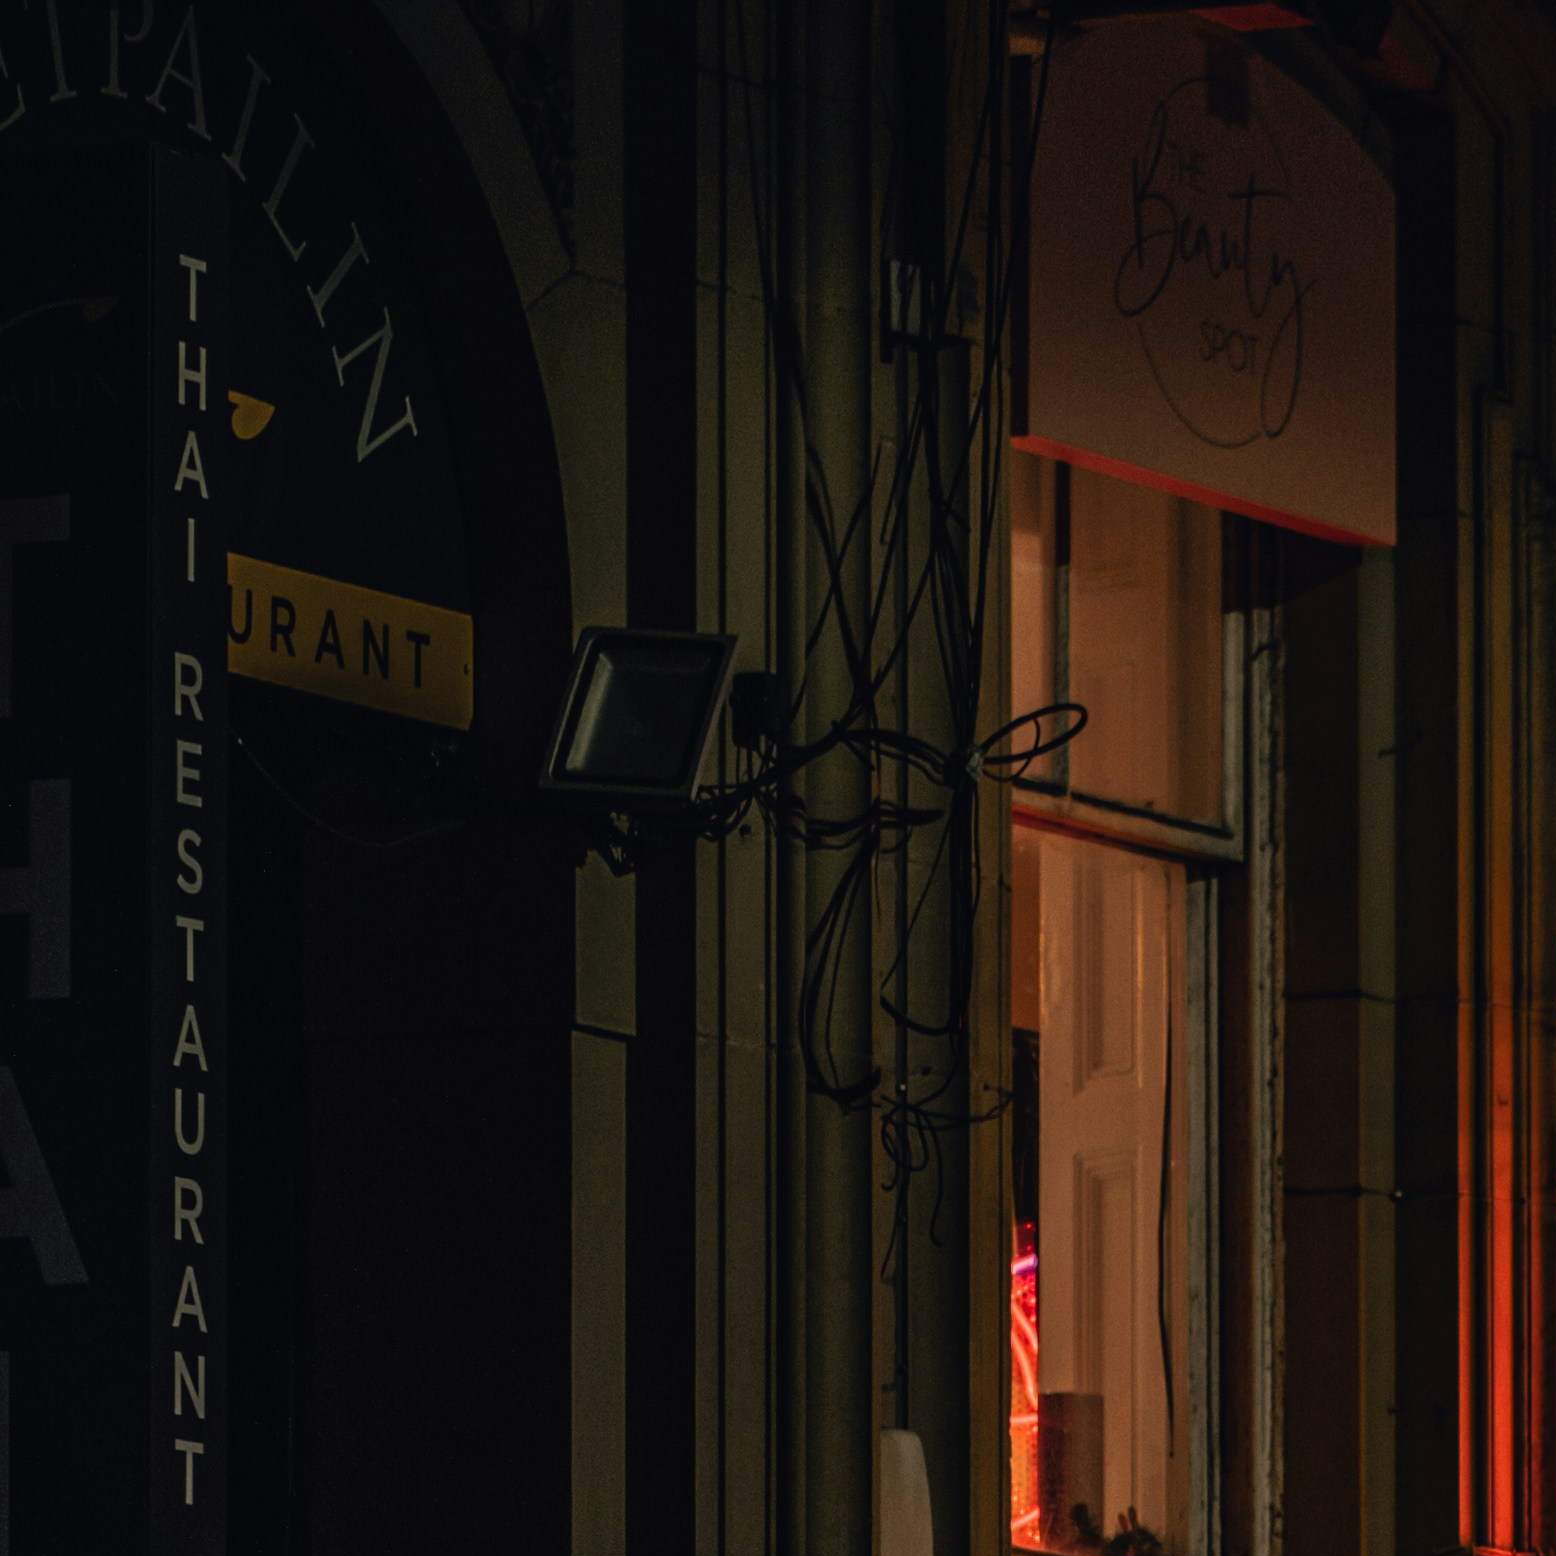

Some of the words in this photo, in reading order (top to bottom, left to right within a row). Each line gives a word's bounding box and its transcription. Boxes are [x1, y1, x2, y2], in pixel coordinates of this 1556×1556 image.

[172, 252, 209, 584] THAI
[1113, 98, 1319, 439] Beauty
[1199, 319, 1260, 376] SPOT
[171, 655, 209, 1506] RESTAURANT
